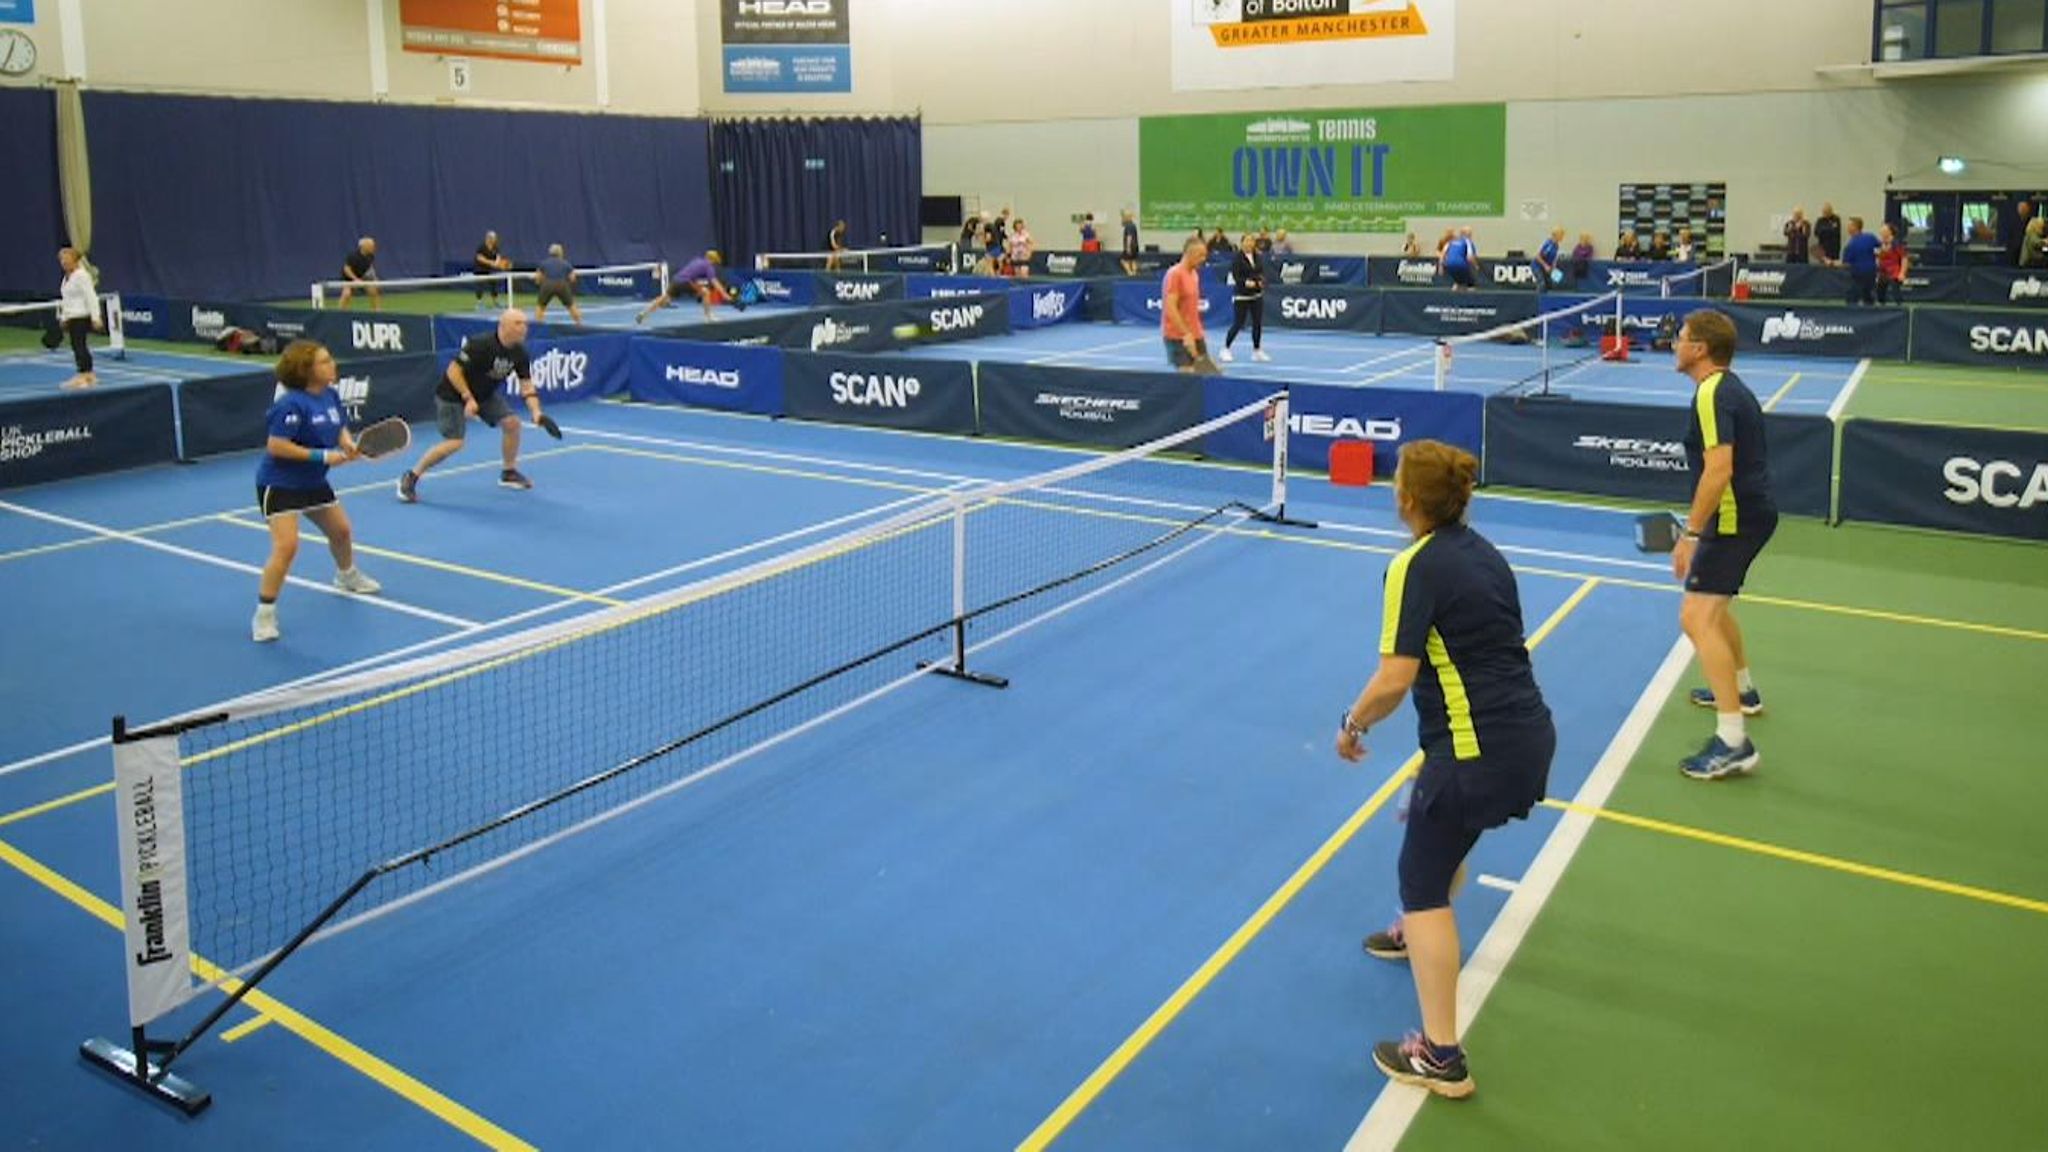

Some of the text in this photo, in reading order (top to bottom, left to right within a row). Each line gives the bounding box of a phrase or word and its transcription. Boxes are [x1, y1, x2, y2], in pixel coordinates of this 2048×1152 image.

[738, 0, 831, 14] HEAD
[1272, 0, 1337, 13] Bolton
[1220, 16, 1411, 41] GREATER MANCHESTER
[454, 68, 464, 87] 5
[1232, 144, 1391, 197] OWN IT
[1147, 299, 1210, 310] HD
[1281, 298, 1337, 318] SCAN
[930, 309, 977, 332] SCAN
[352, 321, 402, 350] DUPR
[665, 365, 739, 387] HEAD
[829, 372, 907, 407] SCAN
[1287, 414, 1401, 441] HEAD
